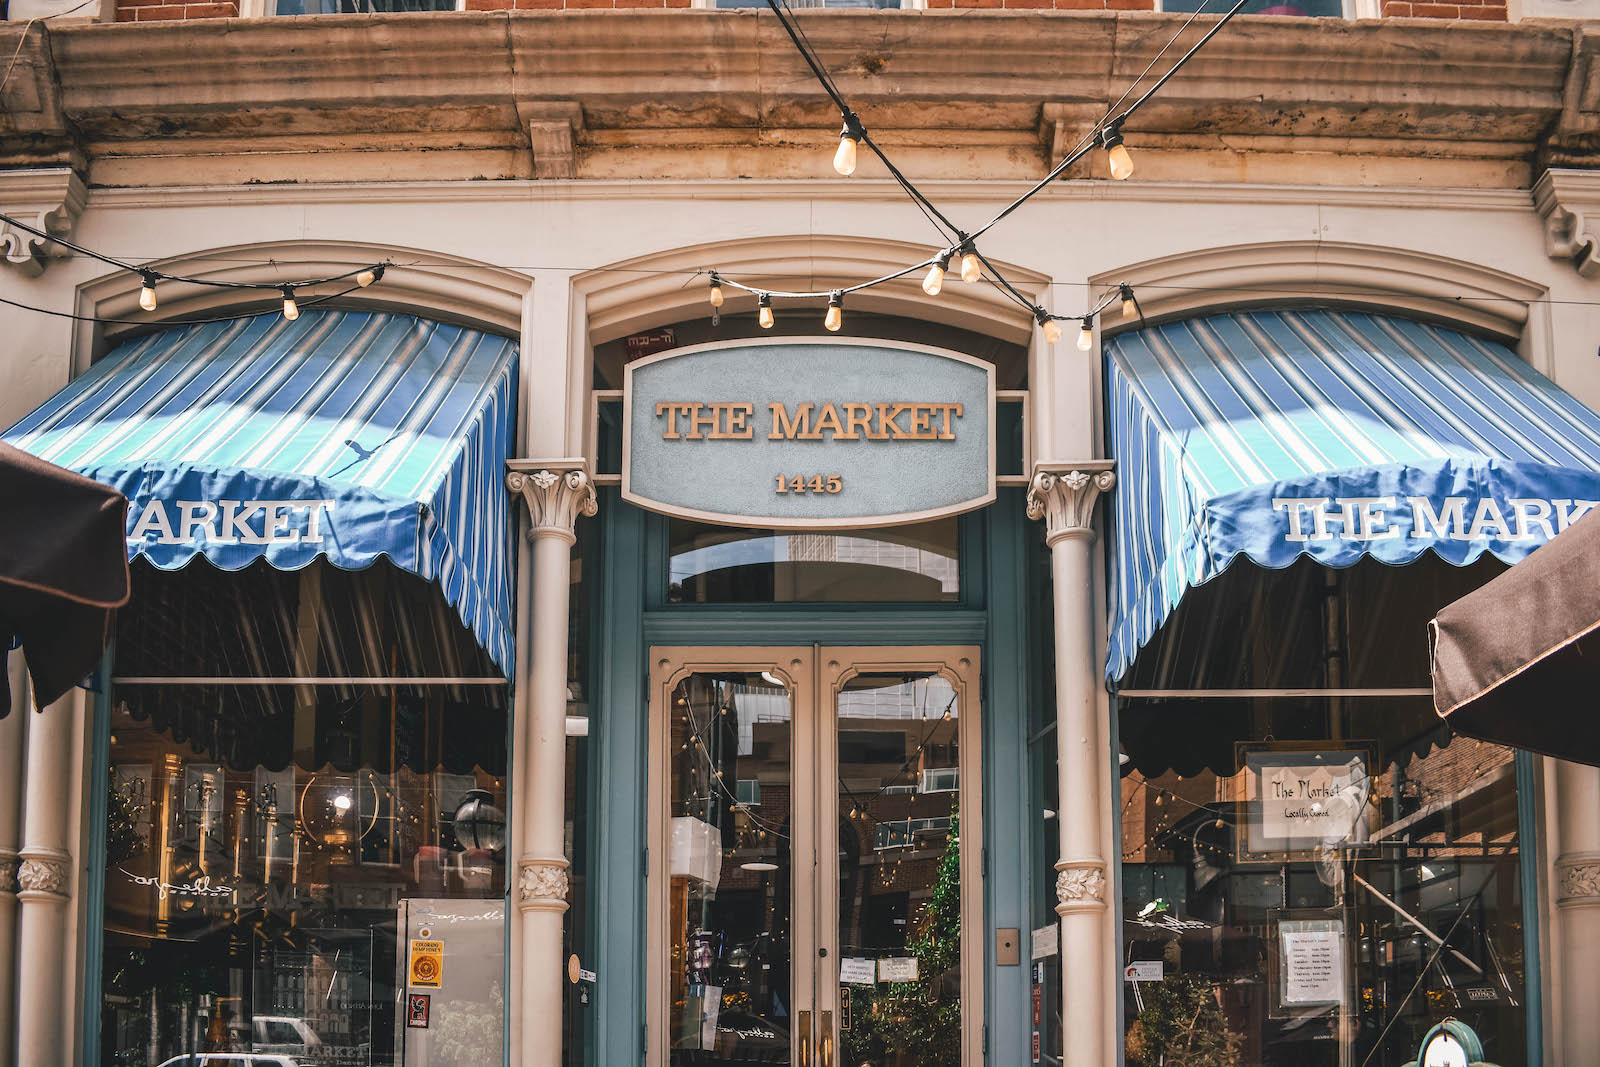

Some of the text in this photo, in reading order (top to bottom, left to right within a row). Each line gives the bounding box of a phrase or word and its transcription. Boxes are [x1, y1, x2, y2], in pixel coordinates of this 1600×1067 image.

[656, 402, 963, 441] THE MARKET
[775, 474, 843, 495] 1445
[127, 499, 335, 544] ARKET
[1272, 496, 1401, 542] THE
[1272, 779, 1341, 799] The Market
[1284, 807, 1309, 821] Locally
